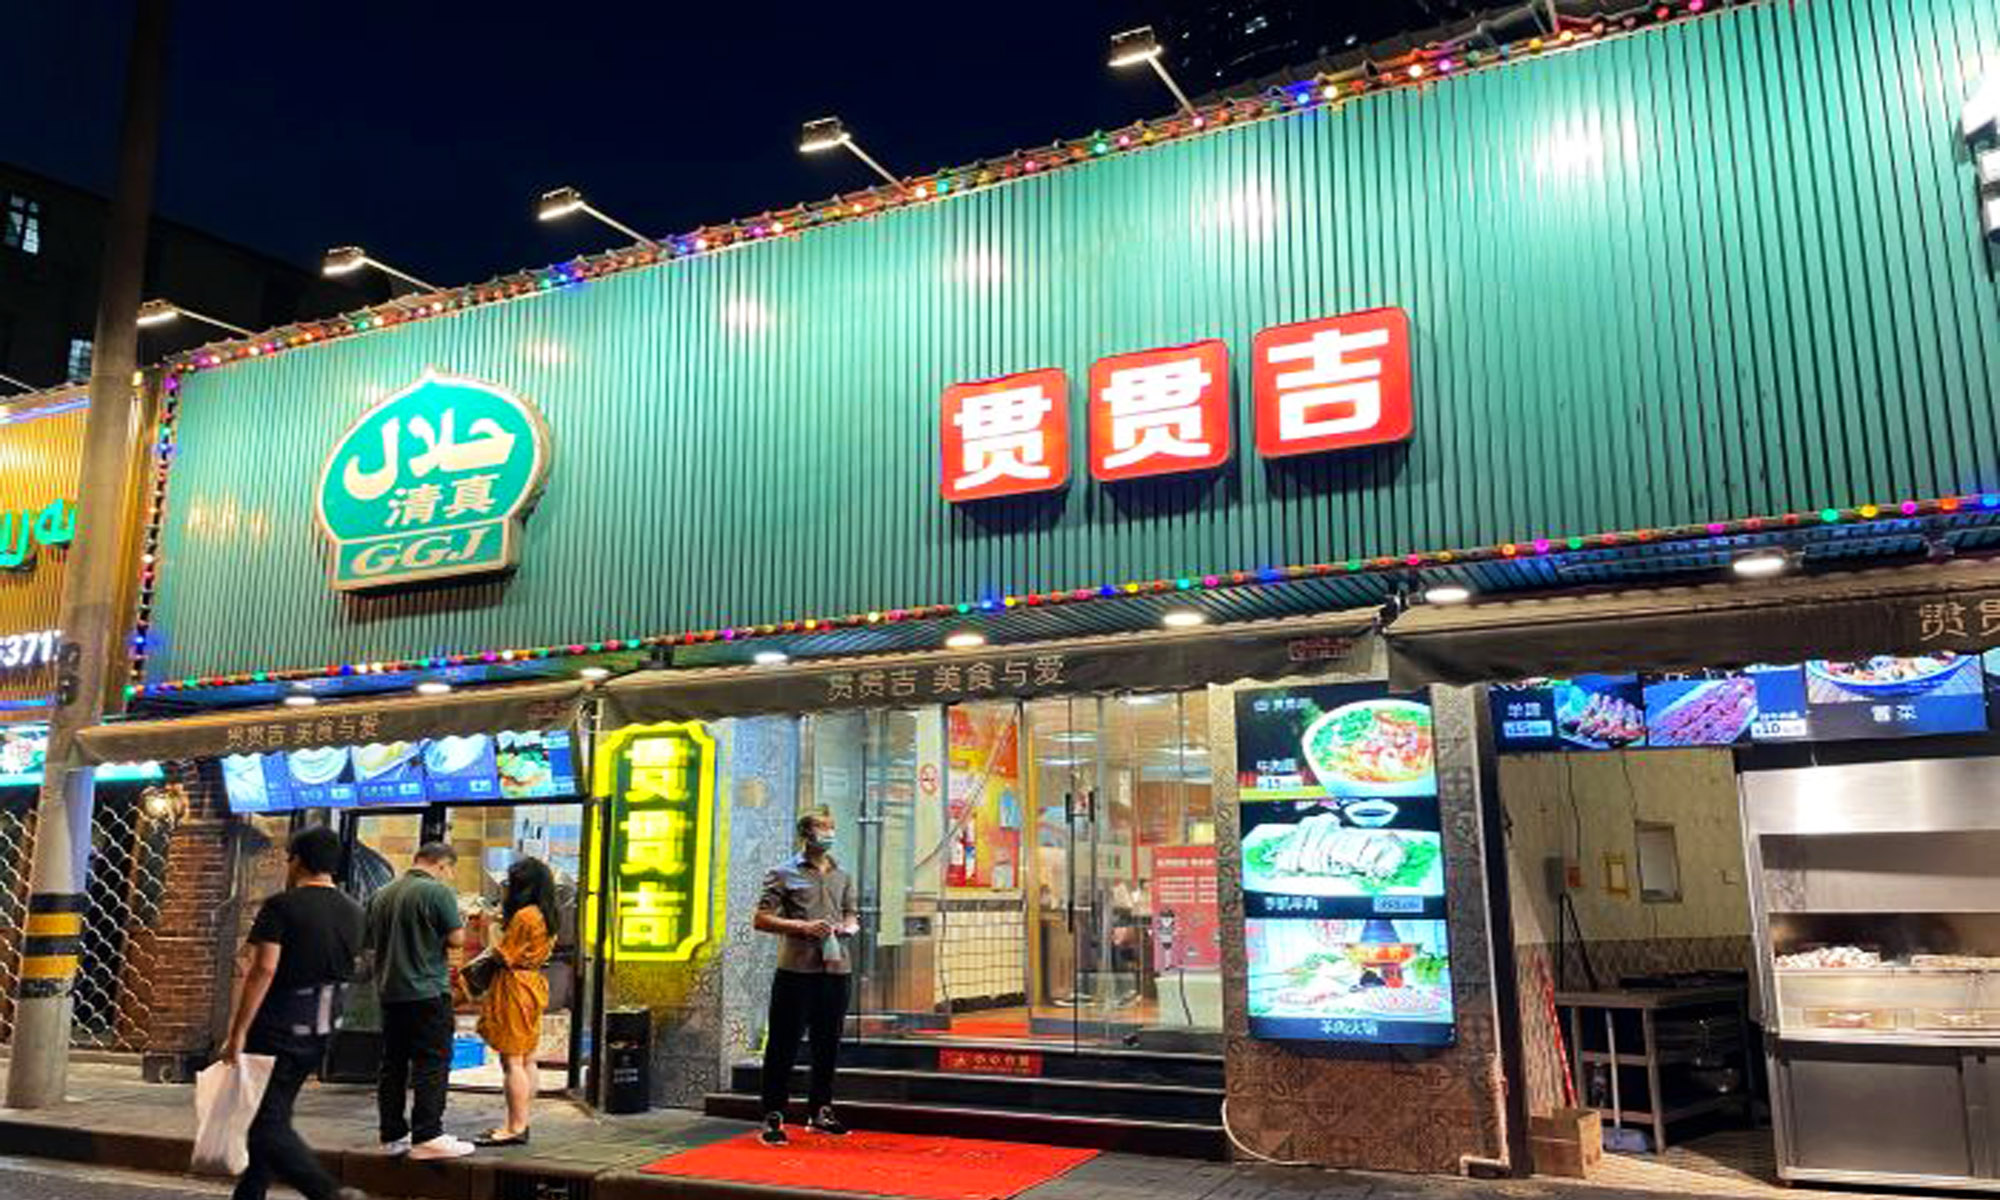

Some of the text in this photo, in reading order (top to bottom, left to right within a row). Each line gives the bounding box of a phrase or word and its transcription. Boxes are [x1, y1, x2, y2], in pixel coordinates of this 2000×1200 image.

[953, 328, 1390, 491] 贯贯吉
[343, 408, 516, 499] حلال
[386, 473, 501, 527] 清真
[352, 527, 490, 575] GGJ
[932, 654, 1065, 694] 美食与爱
